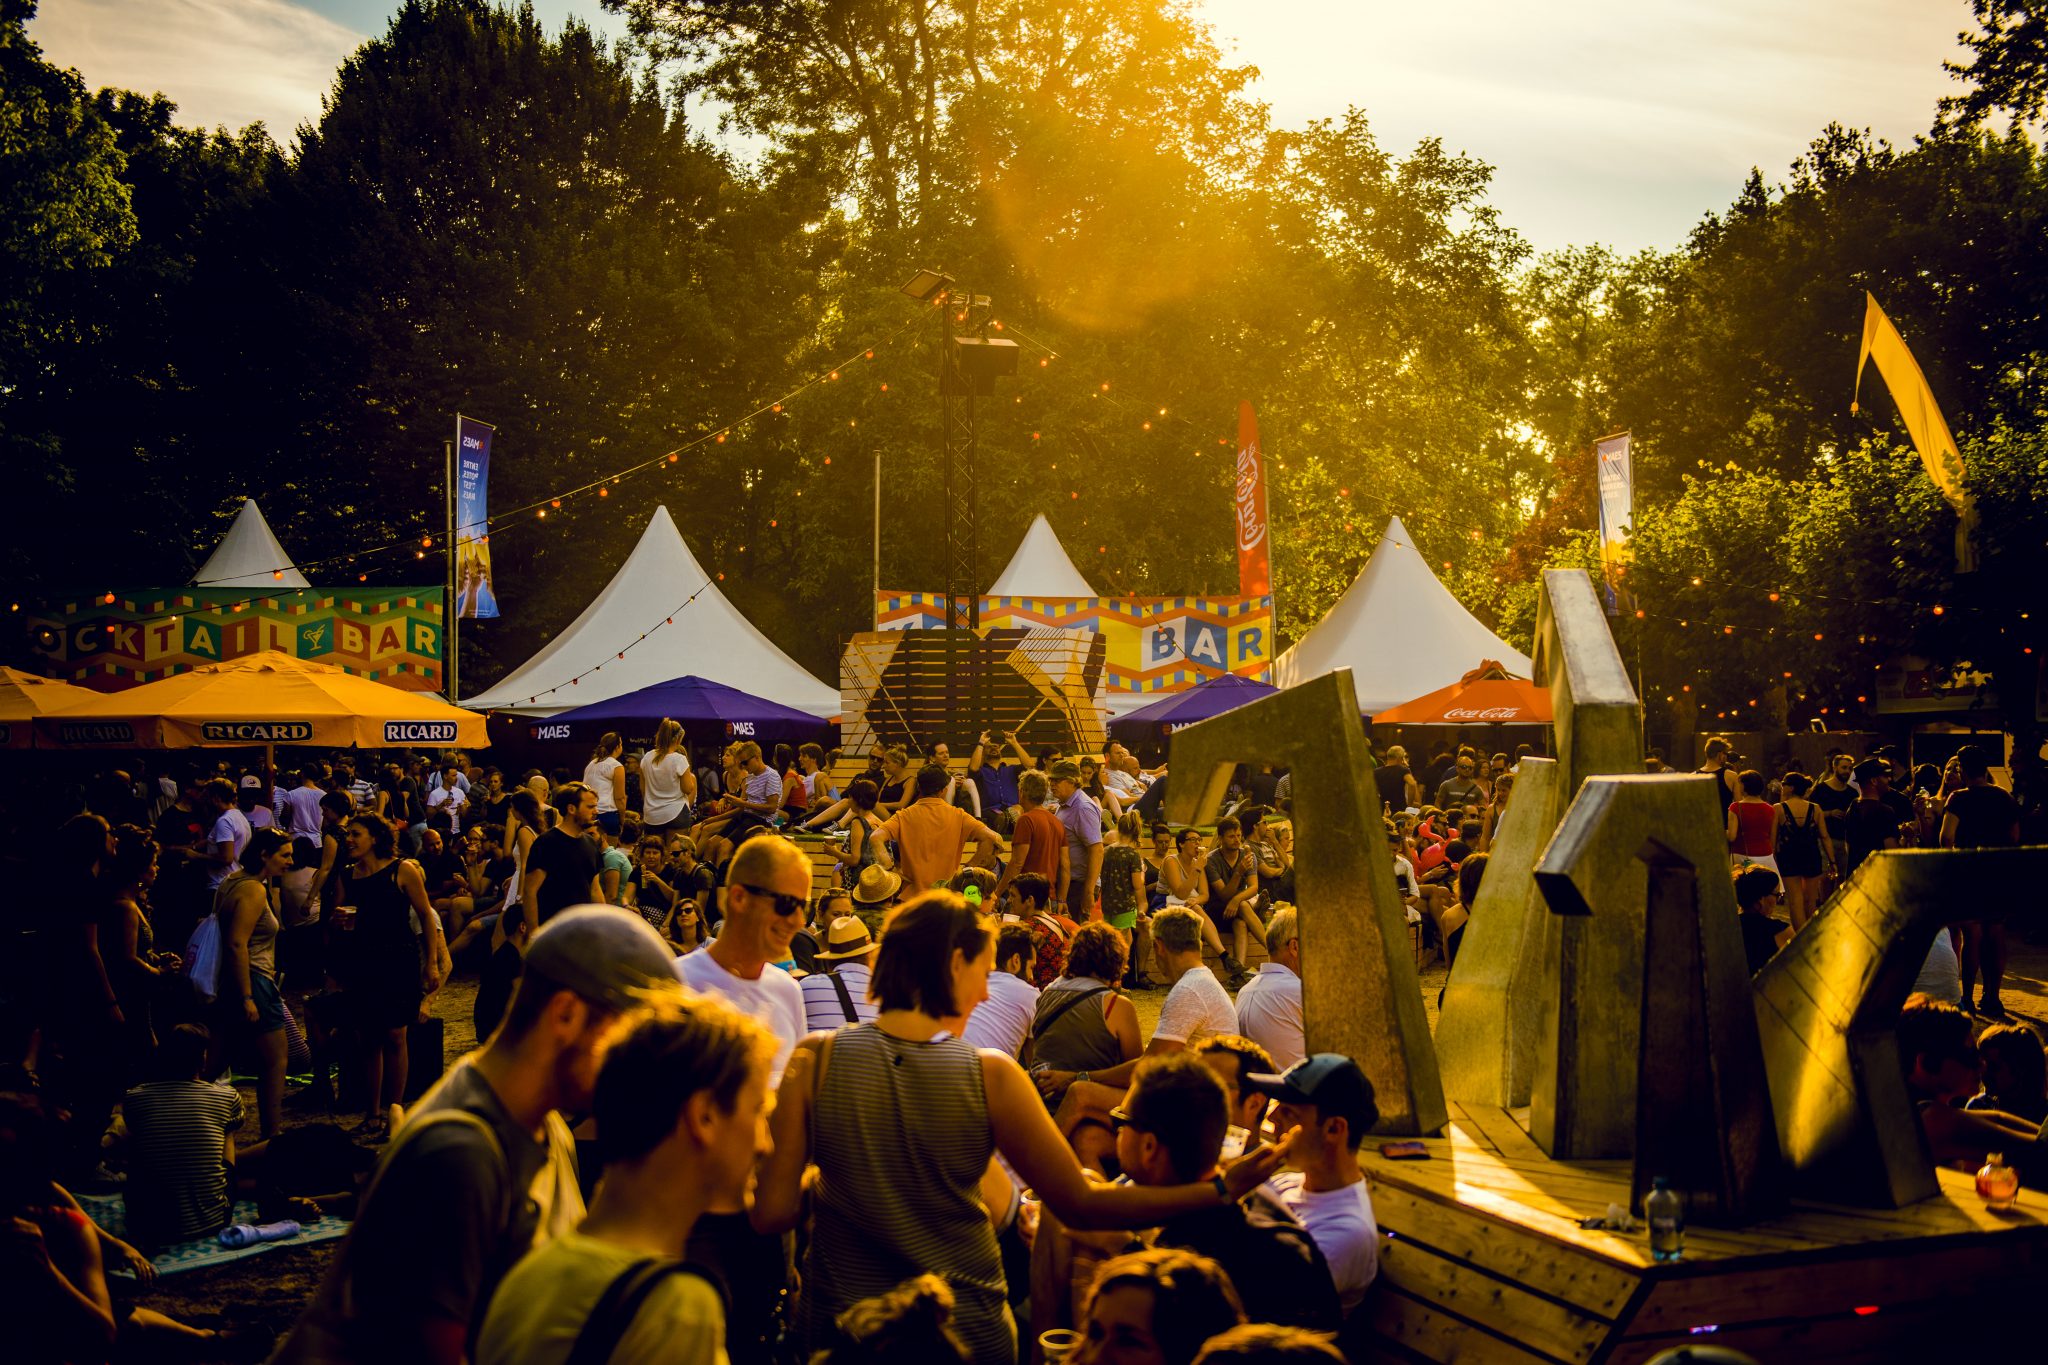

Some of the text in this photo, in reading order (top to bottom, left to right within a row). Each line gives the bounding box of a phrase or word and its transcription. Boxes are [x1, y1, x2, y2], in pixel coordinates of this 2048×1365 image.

[343, 625, 437, 655] BAR
[1152, 626, 1263, 664] BAR
[1443, 707, 1521, 719] Coca-Cola
[64, 726, 131, 741] RICARD
[206, 725, 309, 740] RICARD
[387, 724, 455, 740] RICARD
[537, 724, 571, 740] MAES
[731, 722, 755, 735] MAES
